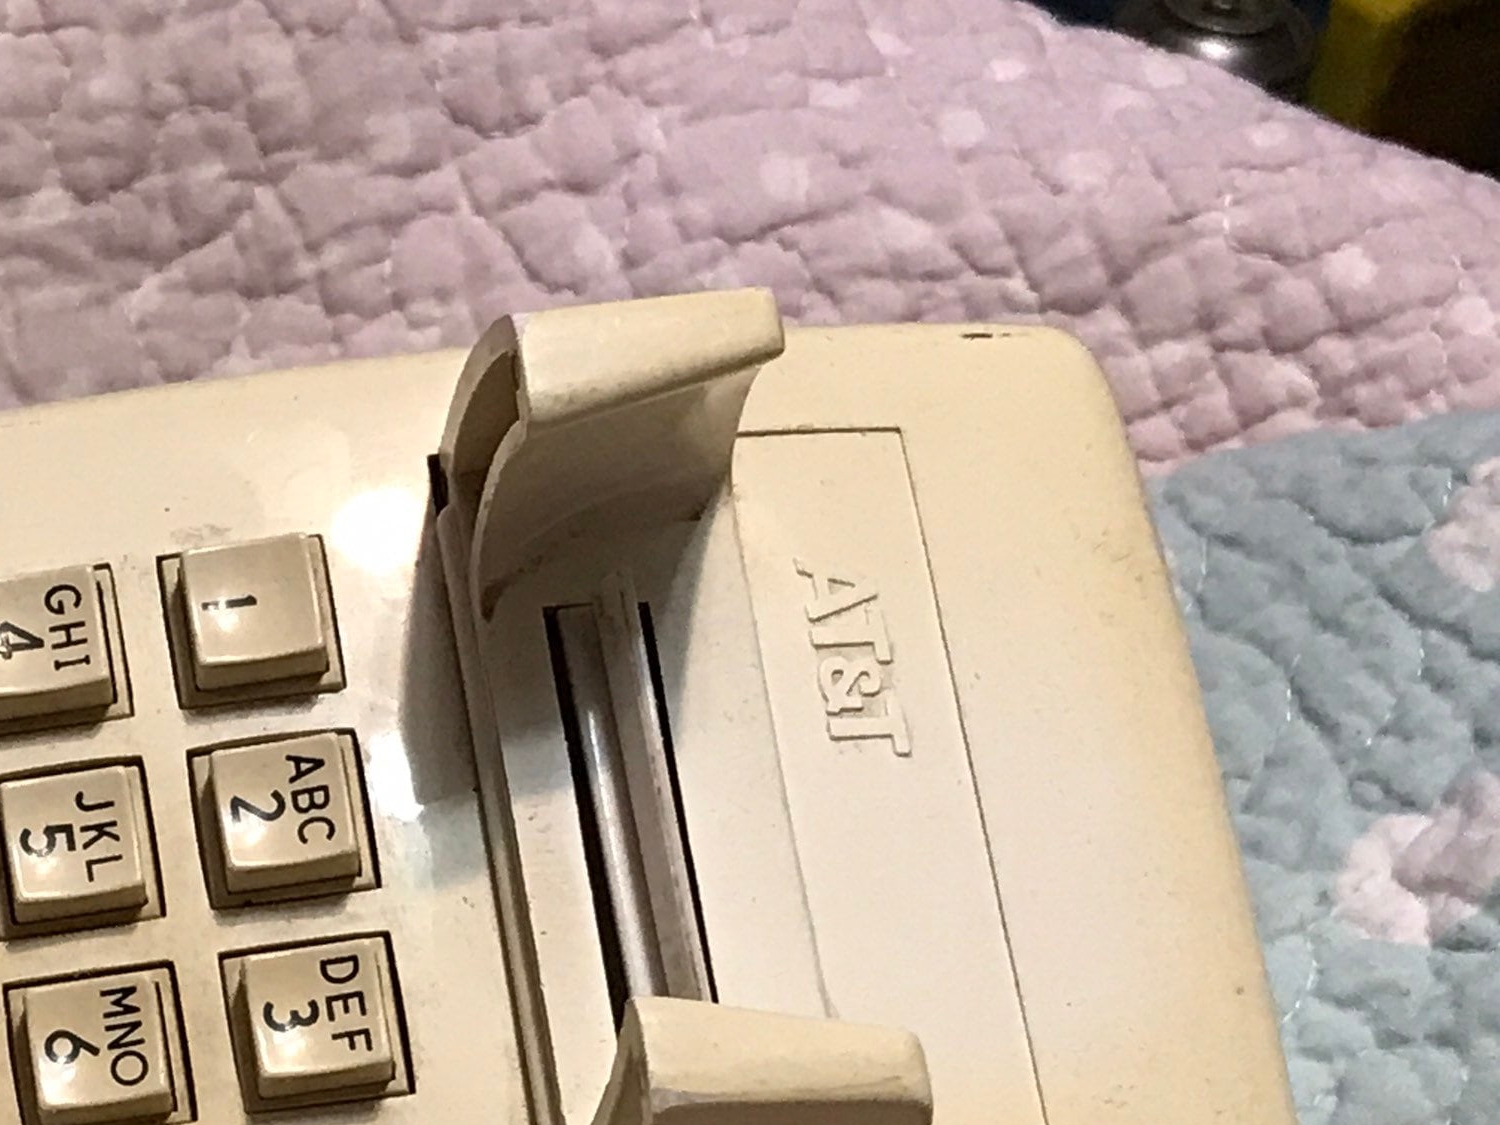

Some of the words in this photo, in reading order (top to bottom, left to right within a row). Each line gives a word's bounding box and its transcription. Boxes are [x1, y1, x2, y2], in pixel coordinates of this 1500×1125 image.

[43, 583, 92, 671] GHI
[791, 557, 913, 758] AT&T
[19, 823, 77, 857] 5
[74, 790, 124, 883] JKL
[229, 789, 286, 824] 2
[284, 753, 337, 845] ABC
[43, 1029, 101, 1065] 6
[99, 985, 150, 1087] MNO
[263, 999, 320, 1033] 3
[319, 954, 374, 1053] DEF
